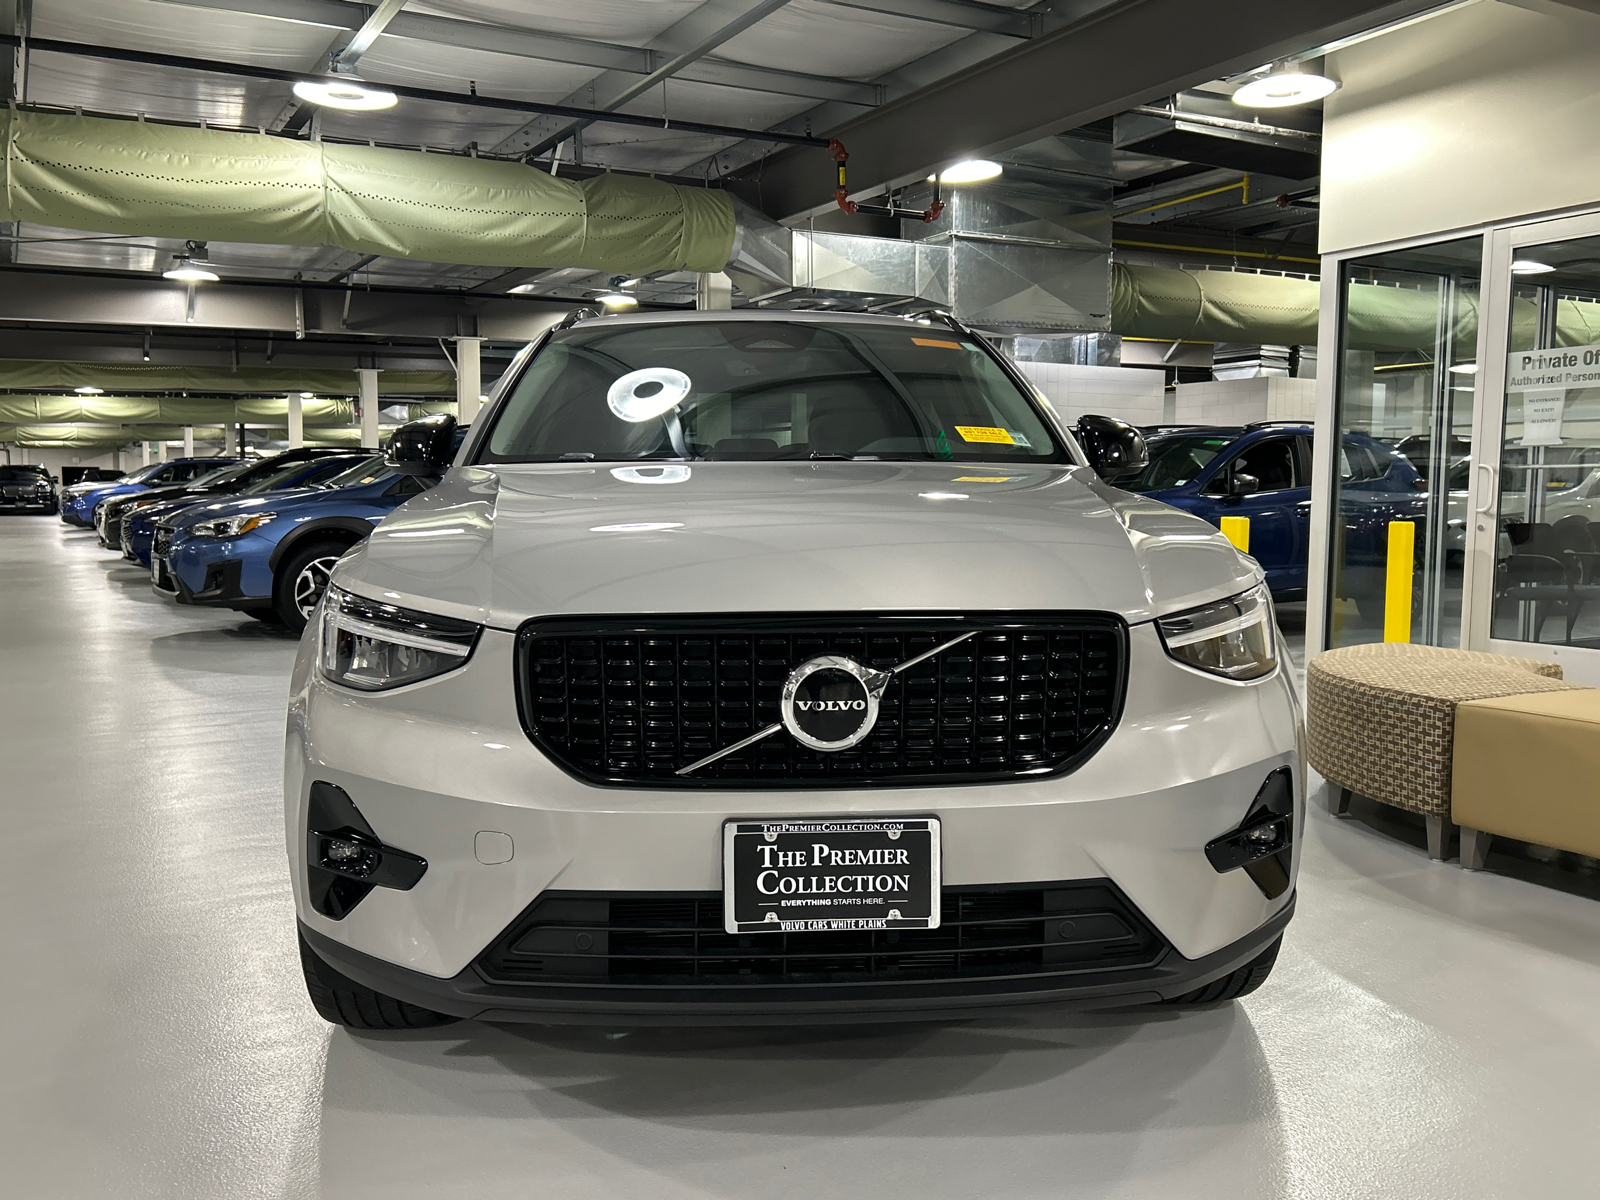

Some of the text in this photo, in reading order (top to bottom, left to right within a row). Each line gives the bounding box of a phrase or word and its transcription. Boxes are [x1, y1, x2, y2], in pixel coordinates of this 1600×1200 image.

[1522, 353, 1578, 370] Private
[1510, 372, 1600, 386] Authorized Person
[796, 700, 866, 711] VOLVO
[756, 843, 910, 868] THE PREMIER
[756, 870, 910, 895] COLLECTION
[781, 899, 831, 907] EVERYTHING
[780, 919, 887, 931] VOLVO CARS WHITE PLAINS
